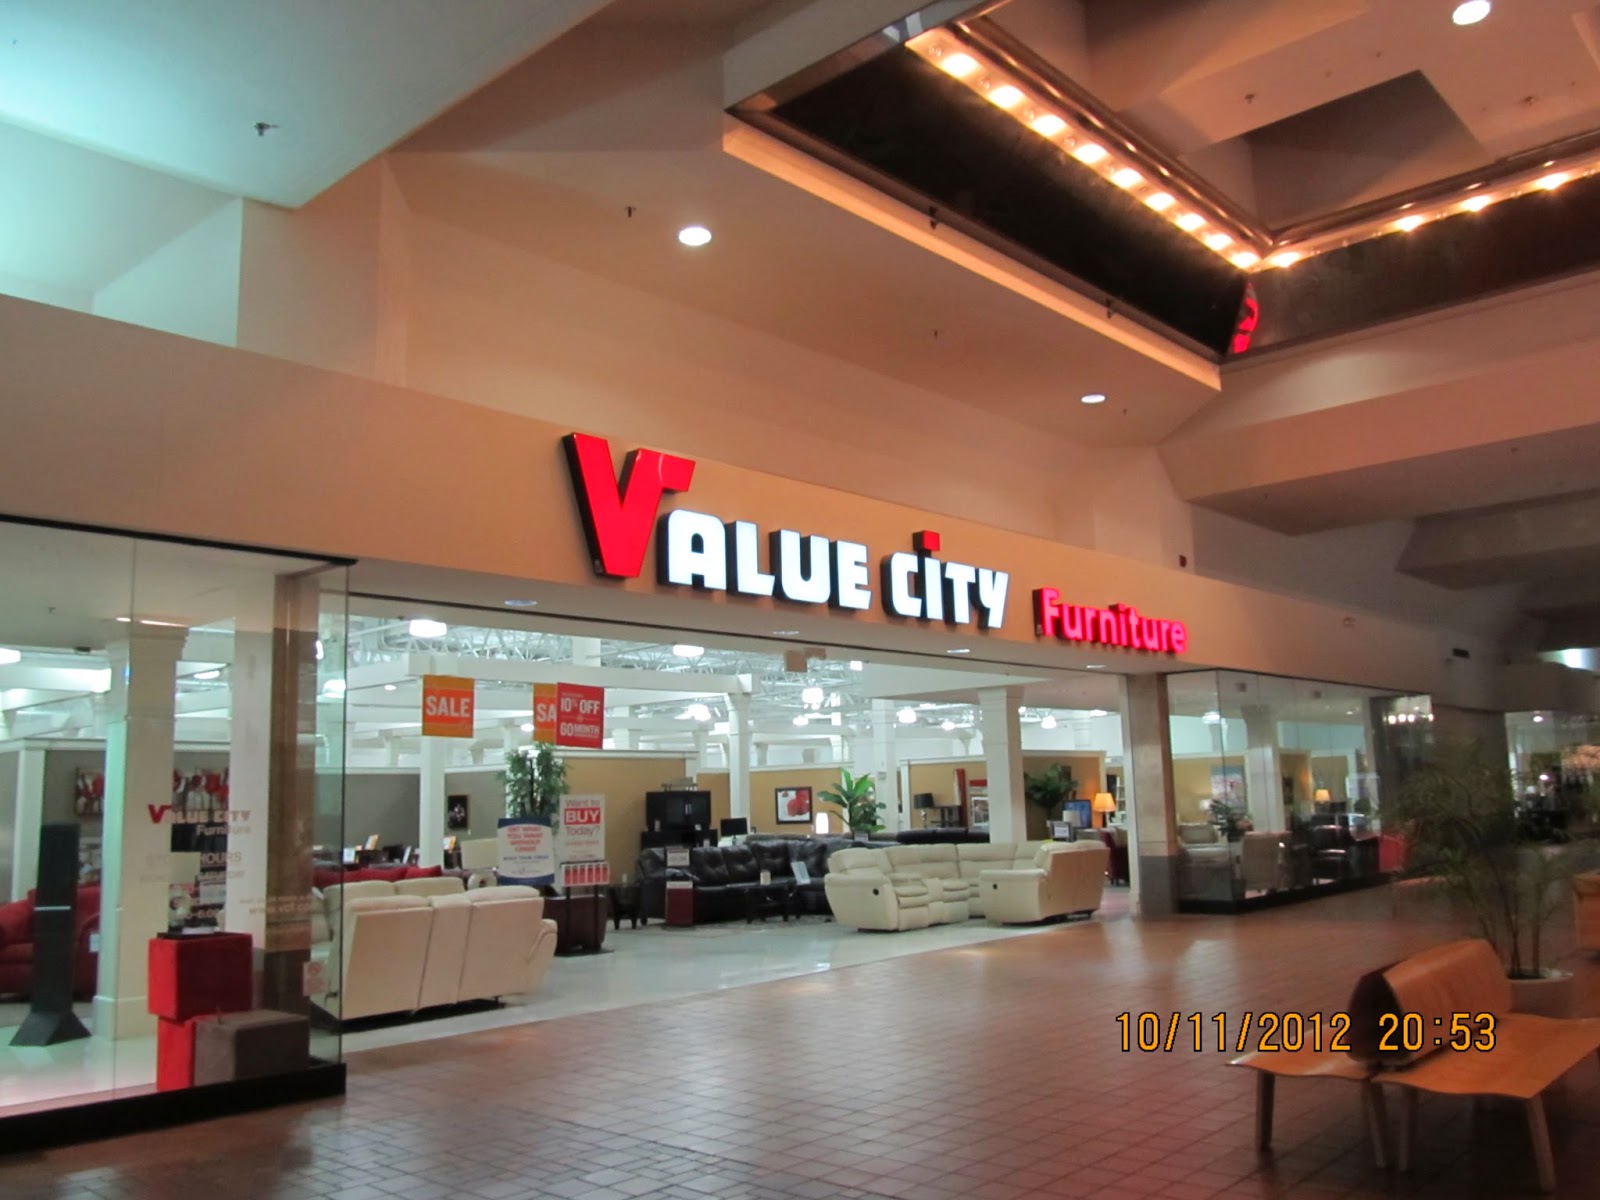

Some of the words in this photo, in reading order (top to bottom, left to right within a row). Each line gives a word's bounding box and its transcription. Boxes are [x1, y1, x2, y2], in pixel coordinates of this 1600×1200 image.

[564, 432, 872, 611] VALUE
[884, 530, 1009, 629] CITY
[1034, 587, 1188, 653] Furniture
[425, 695, 471, 718] SALE
[536, 703, 557, 722] SA
[579, 699, 600, 715] OFF
[560, 722, 574, 736] 60
[566, 809, 600, 823] BUY
[565, 825, 601, 836] Today?
